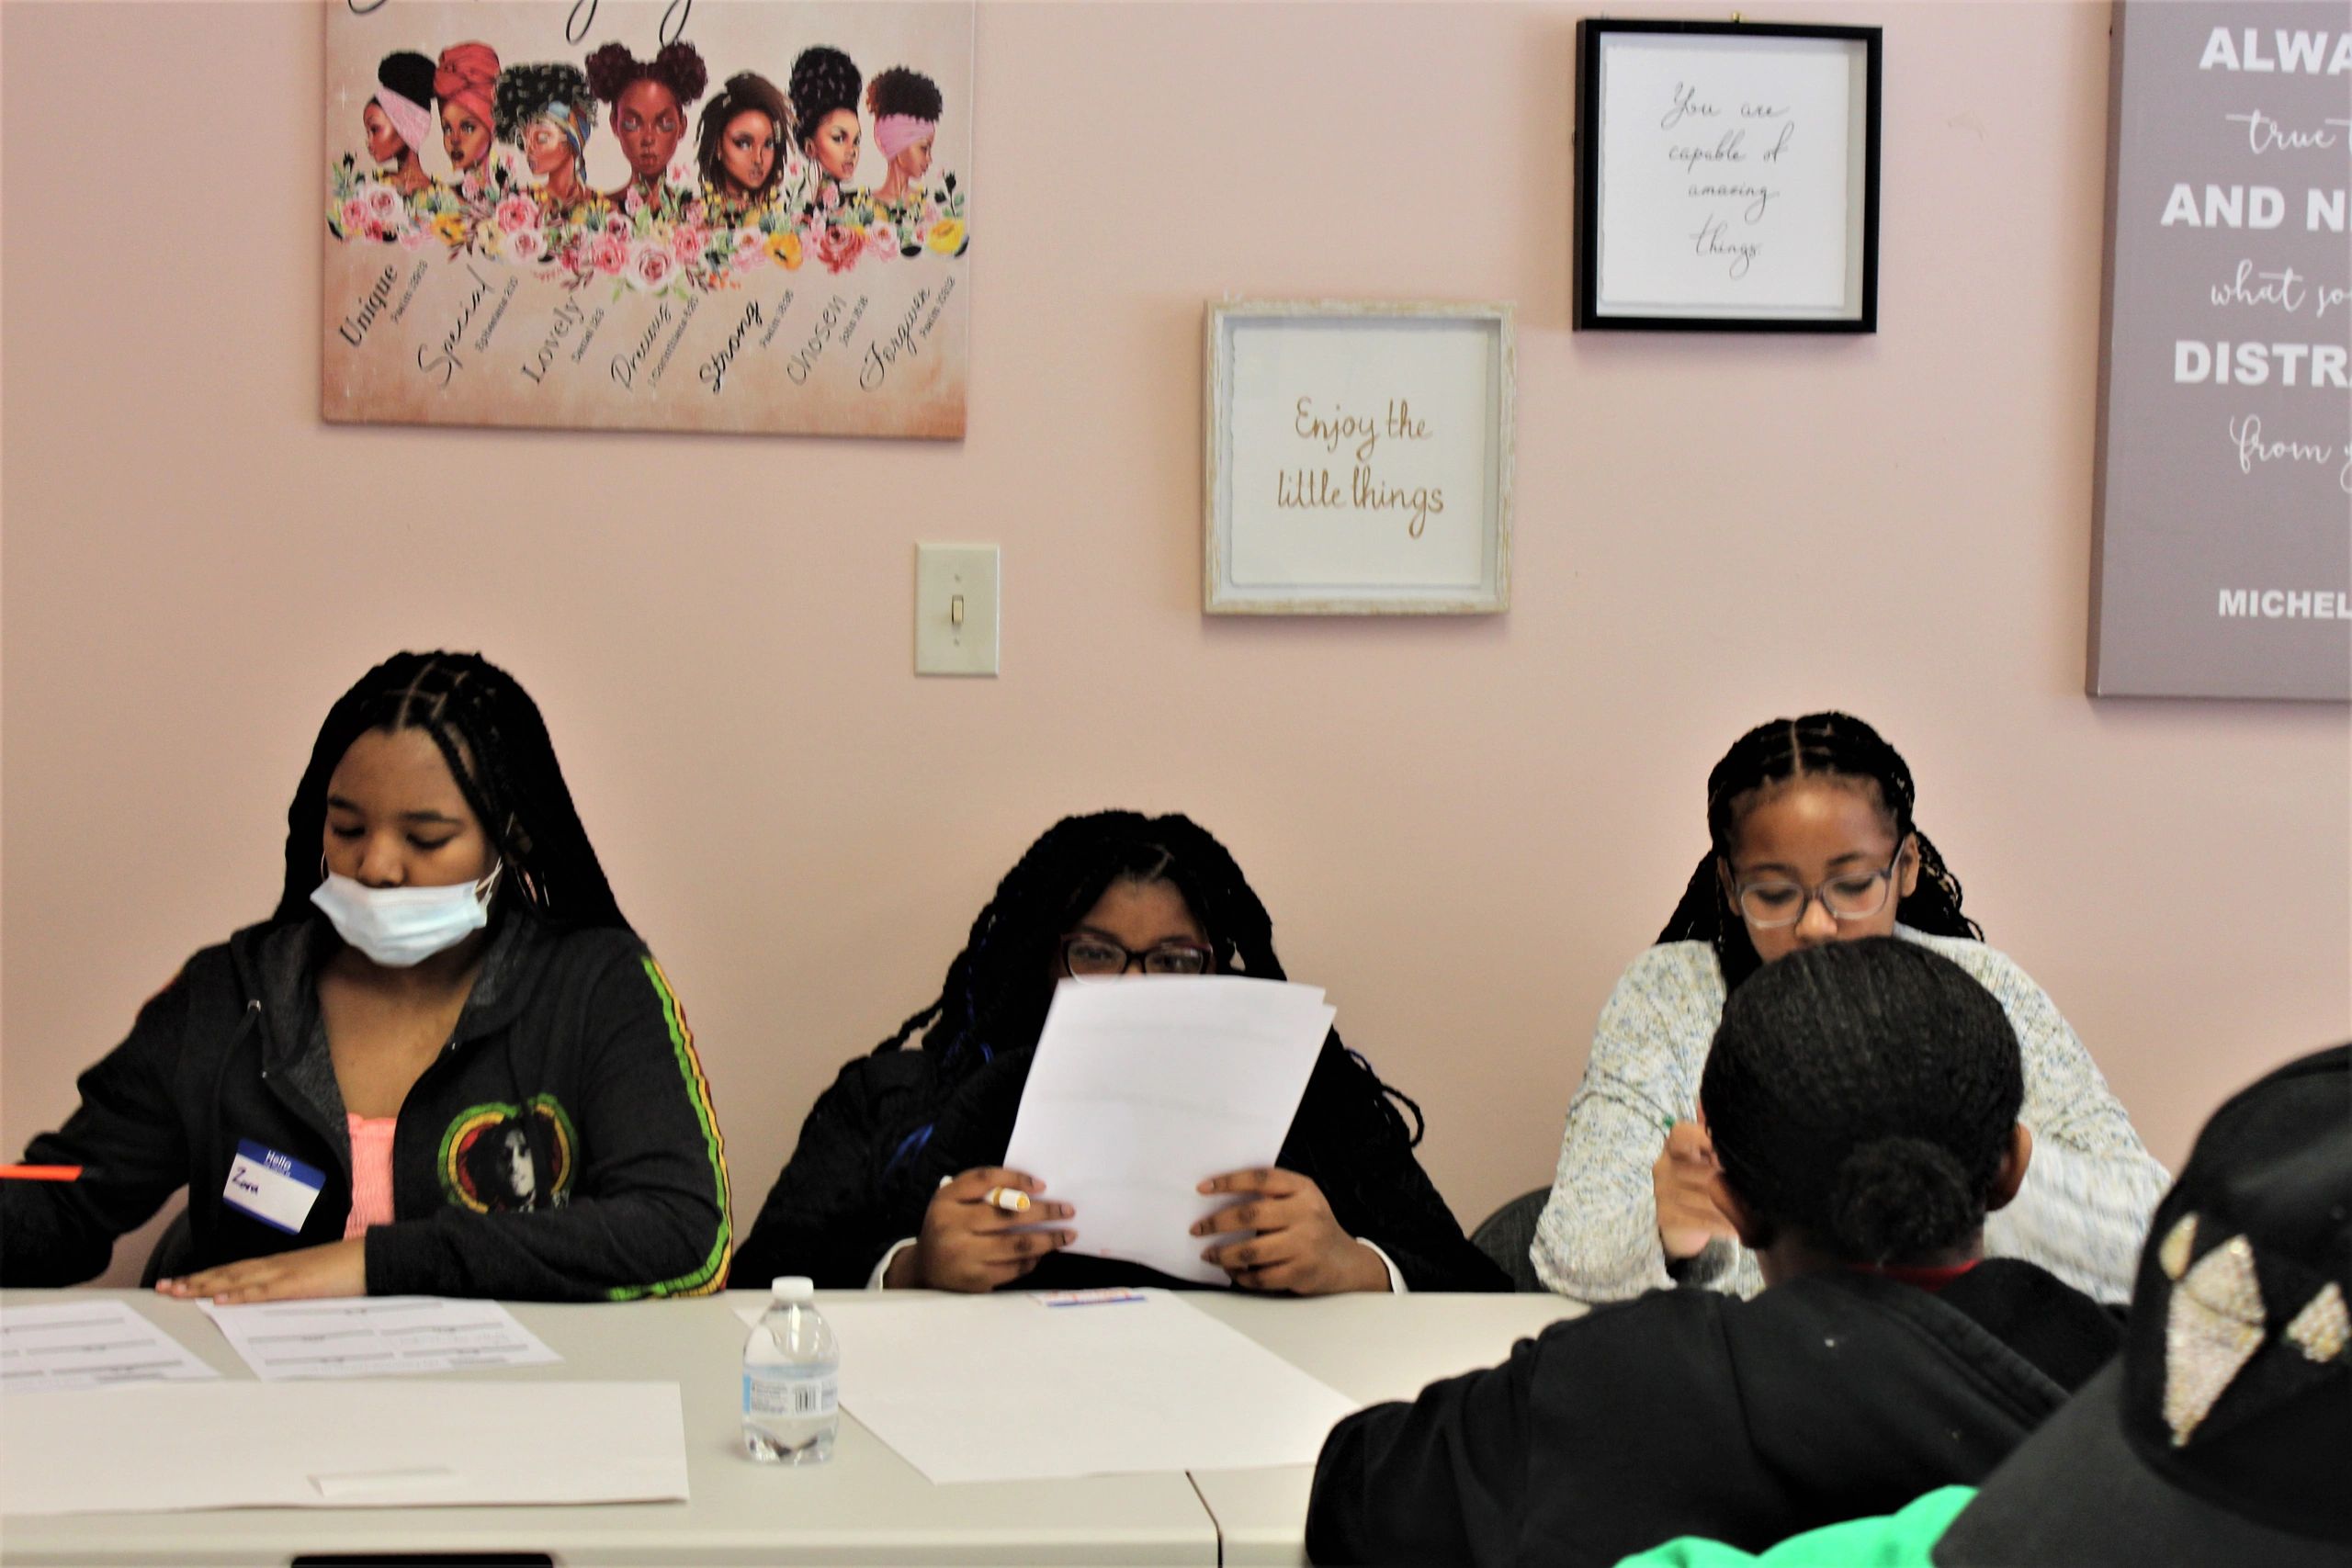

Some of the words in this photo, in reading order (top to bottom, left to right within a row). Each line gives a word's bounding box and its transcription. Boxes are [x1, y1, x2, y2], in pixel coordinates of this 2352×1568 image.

[2199, 27, 2352, 74] ALWA
[1661, 81, 1721, 130] You
[1740, 103, 1791, 118] are
[2225, 108, 2336, 154] true
[1668, 129, 1746, 174] capable
[1763, 120, 1794, 164] of
[1688, 179, 1780, 224] amazing
[2160, 183, 2285, 230] AND
[2306, 187, 2352, 232] N
[1690, 213, 1758, 280] things
[339, 265, 397, 348] Unique
[2211, 258, 2306, 312] what
[417, 263, 494, 389] Special
[521, 295, 584, 385] Lovely
[699, 299, 763, 394] Strong
[786, 294, 847, 385] Chosen
[860, 287, 930, 392] Forgiven
[2175, 340, 2352, 388] DISTR
[1295, 396, 1379, 462] Enjoy
[1386, 398, 1433, 440] the
[2229, 413, 2332, 474] from
[1277, 468, 1346, 509] little
[1352, 465, 1444, 539] things
[2219, 589, 2352, 619] MICHEL
[266, 1149, 292, 1171] Hello
